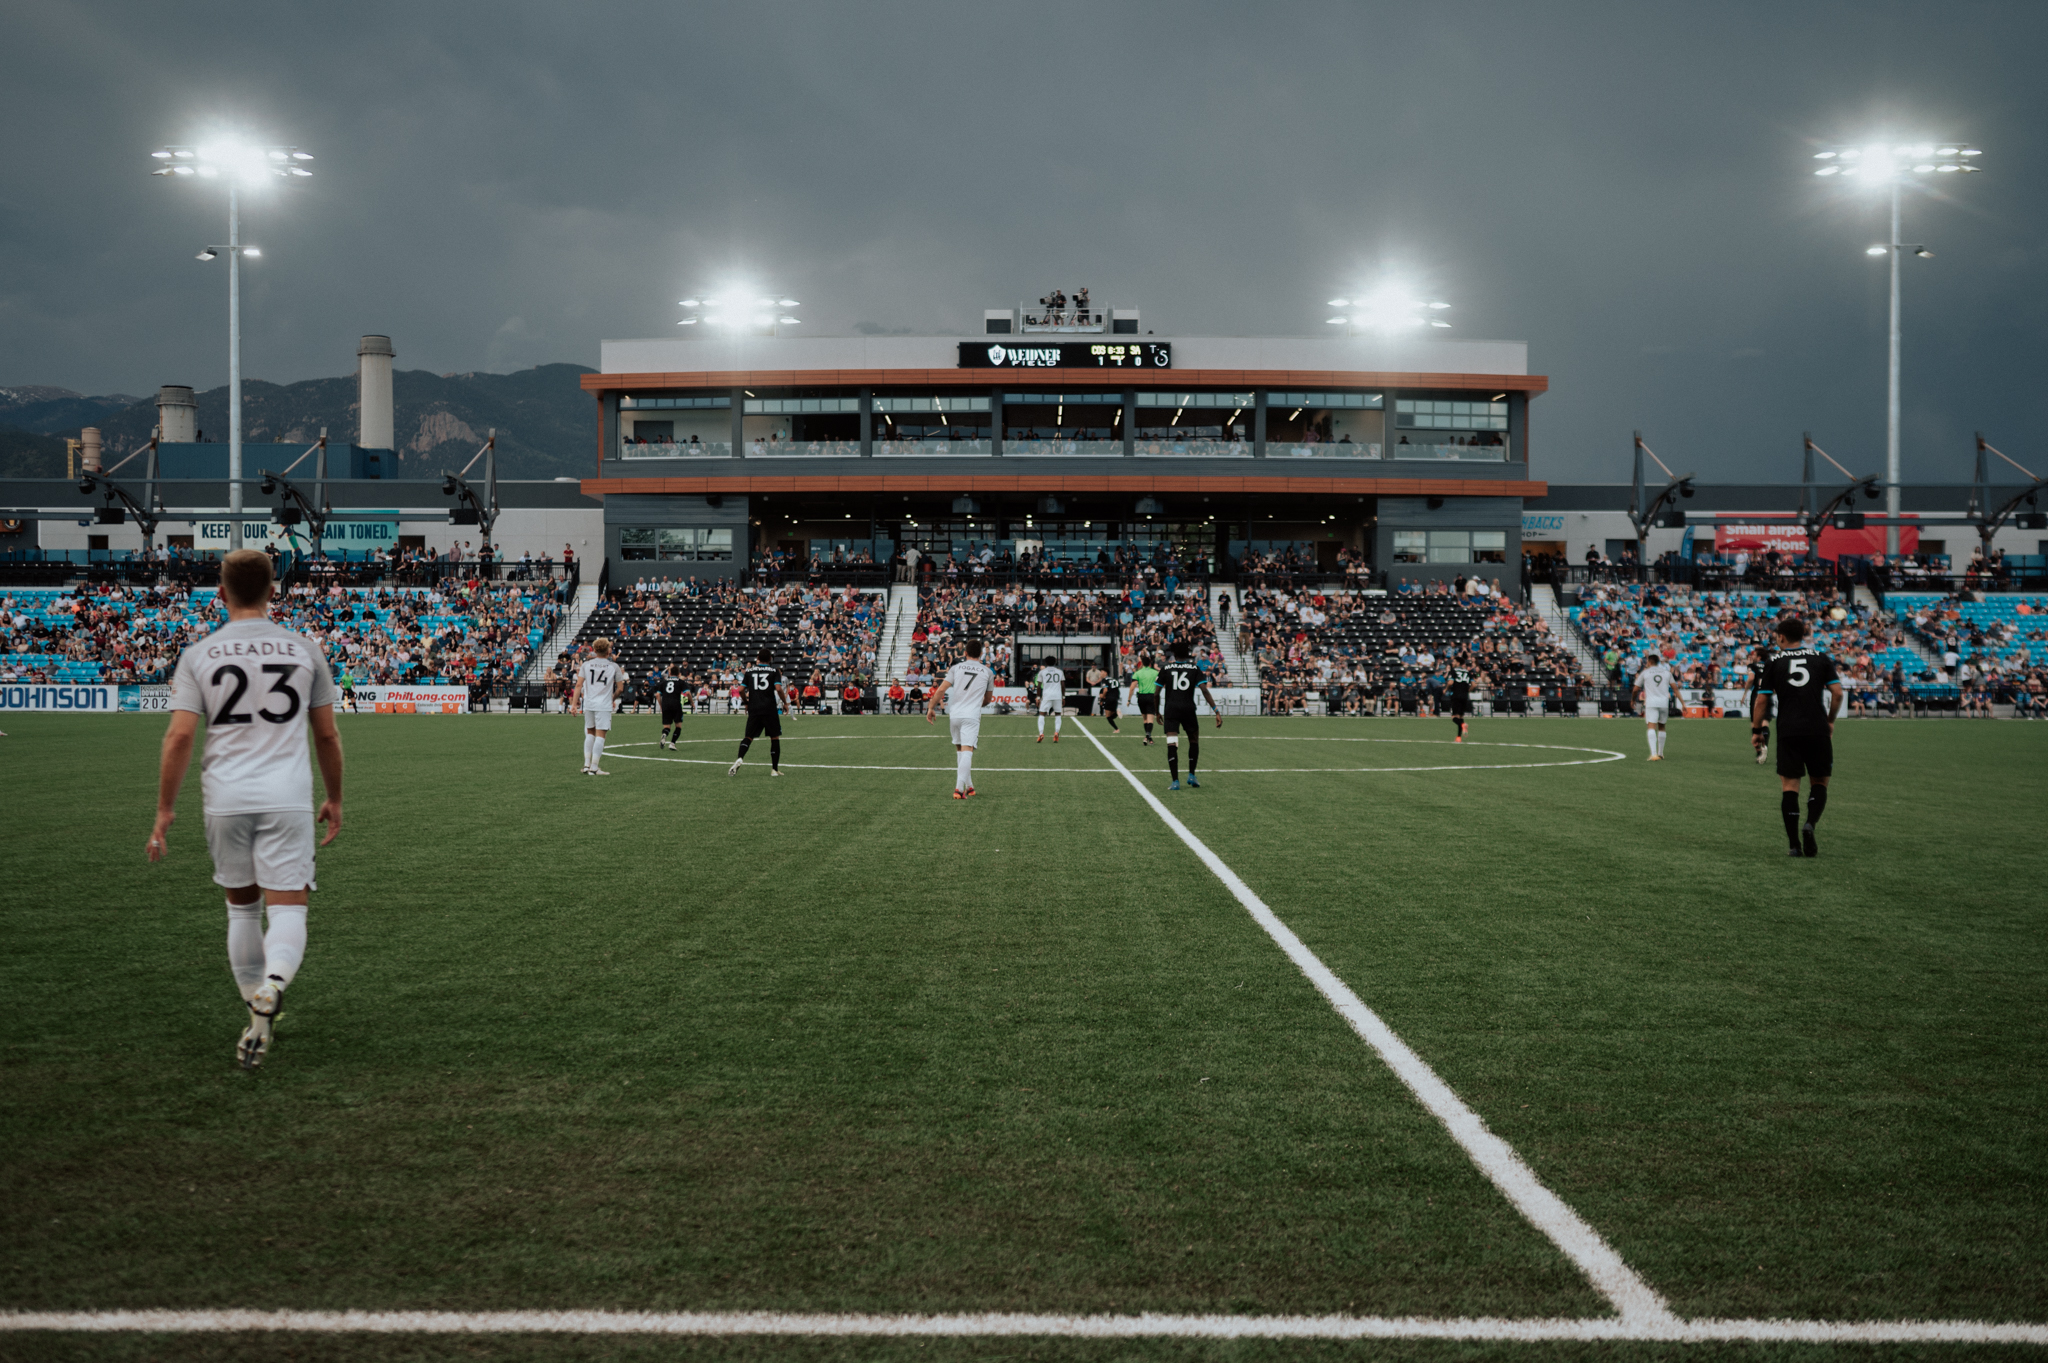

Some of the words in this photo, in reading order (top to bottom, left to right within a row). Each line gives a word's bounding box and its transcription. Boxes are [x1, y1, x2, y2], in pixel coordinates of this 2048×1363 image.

[1007, 348, 1061, 361] WEIDNER
[202, 524, 230, 538] KEEP
[242, 524, 268, 539] OUR
[309, 524, 345, 539] AIN
[349, 524, 392, 539] TONED.
[1726, 525, 1765, 535] Small
[1768, 525, 1808, 537] airpo
[208, 642, 296, 659] GLEADLE
[1770, 649, 1820, 662] MAHONEY
[590, 669, 608, 685] 14
[1045, 673, 1060, 683] 20
[1455, 671, 1470, 683] 34
[1788, 658, 1810, 688] 5
[665, 681, 675, 693] 8
[752, 673, 770, 690] 13
[964, 671, 978, 691] 7
[1171, 671, 1190, 690] 16
[1653, 675, 1662, 687] 9
[211, 664, 300, 726] 23
[387, 691, 466, 703] PhilLong.com
